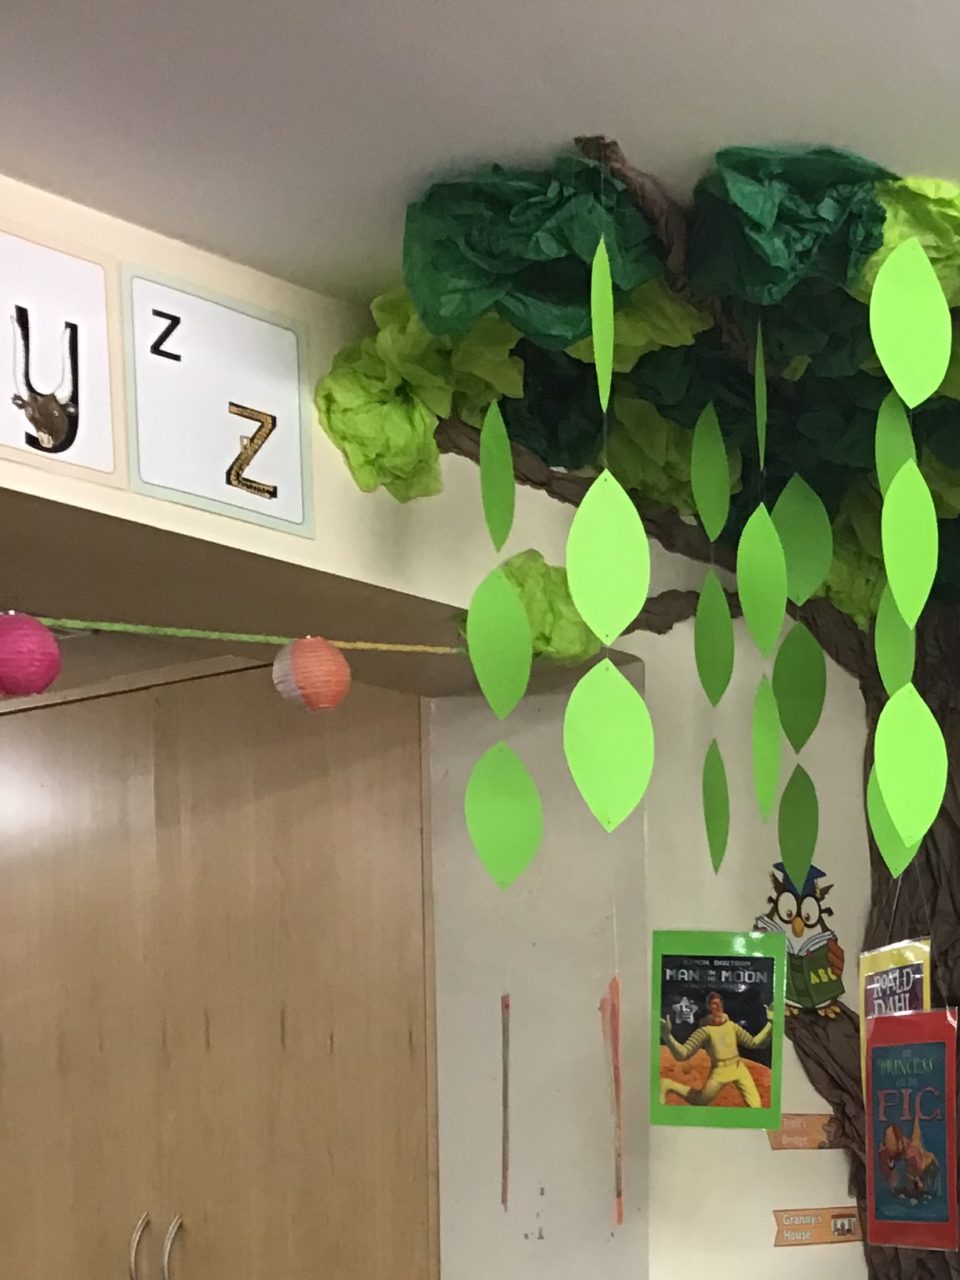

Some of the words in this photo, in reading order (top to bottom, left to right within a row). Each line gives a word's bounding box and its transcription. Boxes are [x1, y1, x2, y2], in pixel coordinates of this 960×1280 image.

[665, 968, 699, 982] MAN
[720, 968, 768, 983] MOON
[872, 967, 914, 999] ROALD
[783, 1230, 812, 1241] House
